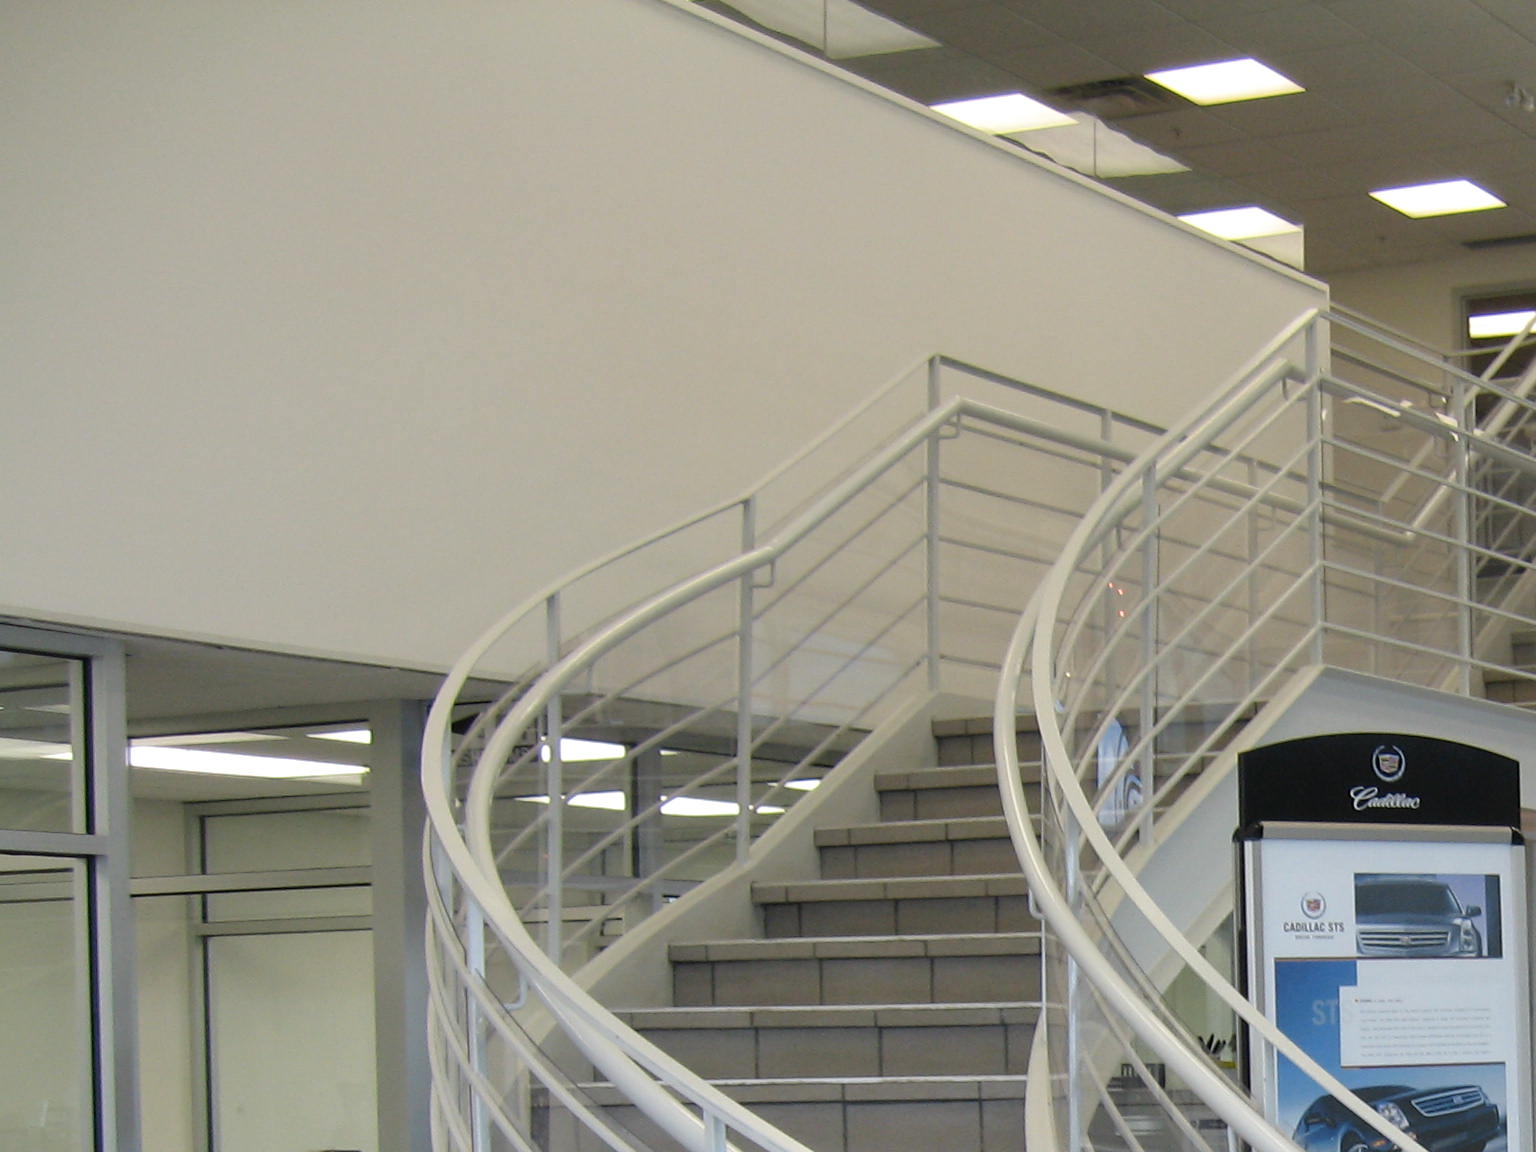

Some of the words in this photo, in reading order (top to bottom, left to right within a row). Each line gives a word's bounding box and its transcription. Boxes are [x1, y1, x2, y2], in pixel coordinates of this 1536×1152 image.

[1350, 786, 1420, 811] Cadillac
[1283, 921, 1325, 933] CADILLAC
[1328, 921, 1345, 933] STS
